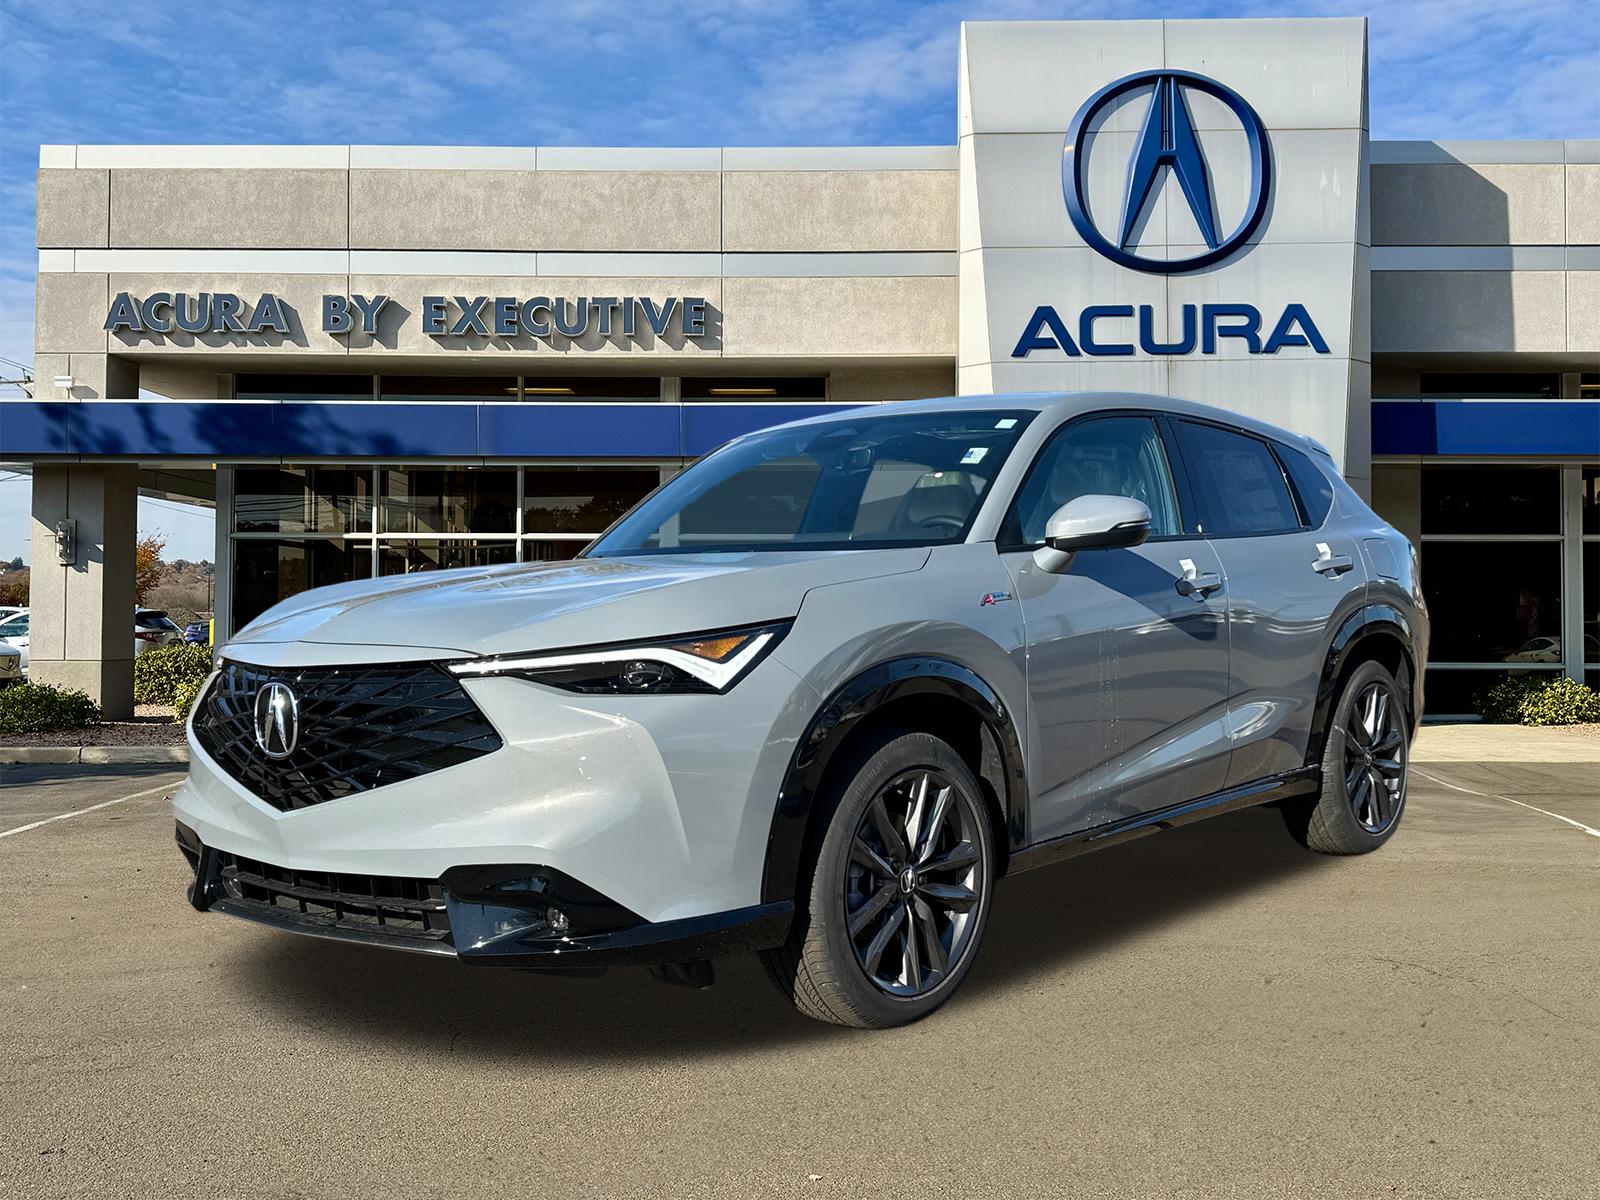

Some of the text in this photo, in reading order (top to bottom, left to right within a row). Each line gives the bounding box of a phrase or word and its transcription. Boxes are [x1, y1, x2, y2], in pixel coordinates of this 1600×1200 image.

[103, 292, 705, 337] ACURA BY EXECUTIVE
[1011, 303, 1331, 357] ACURA
